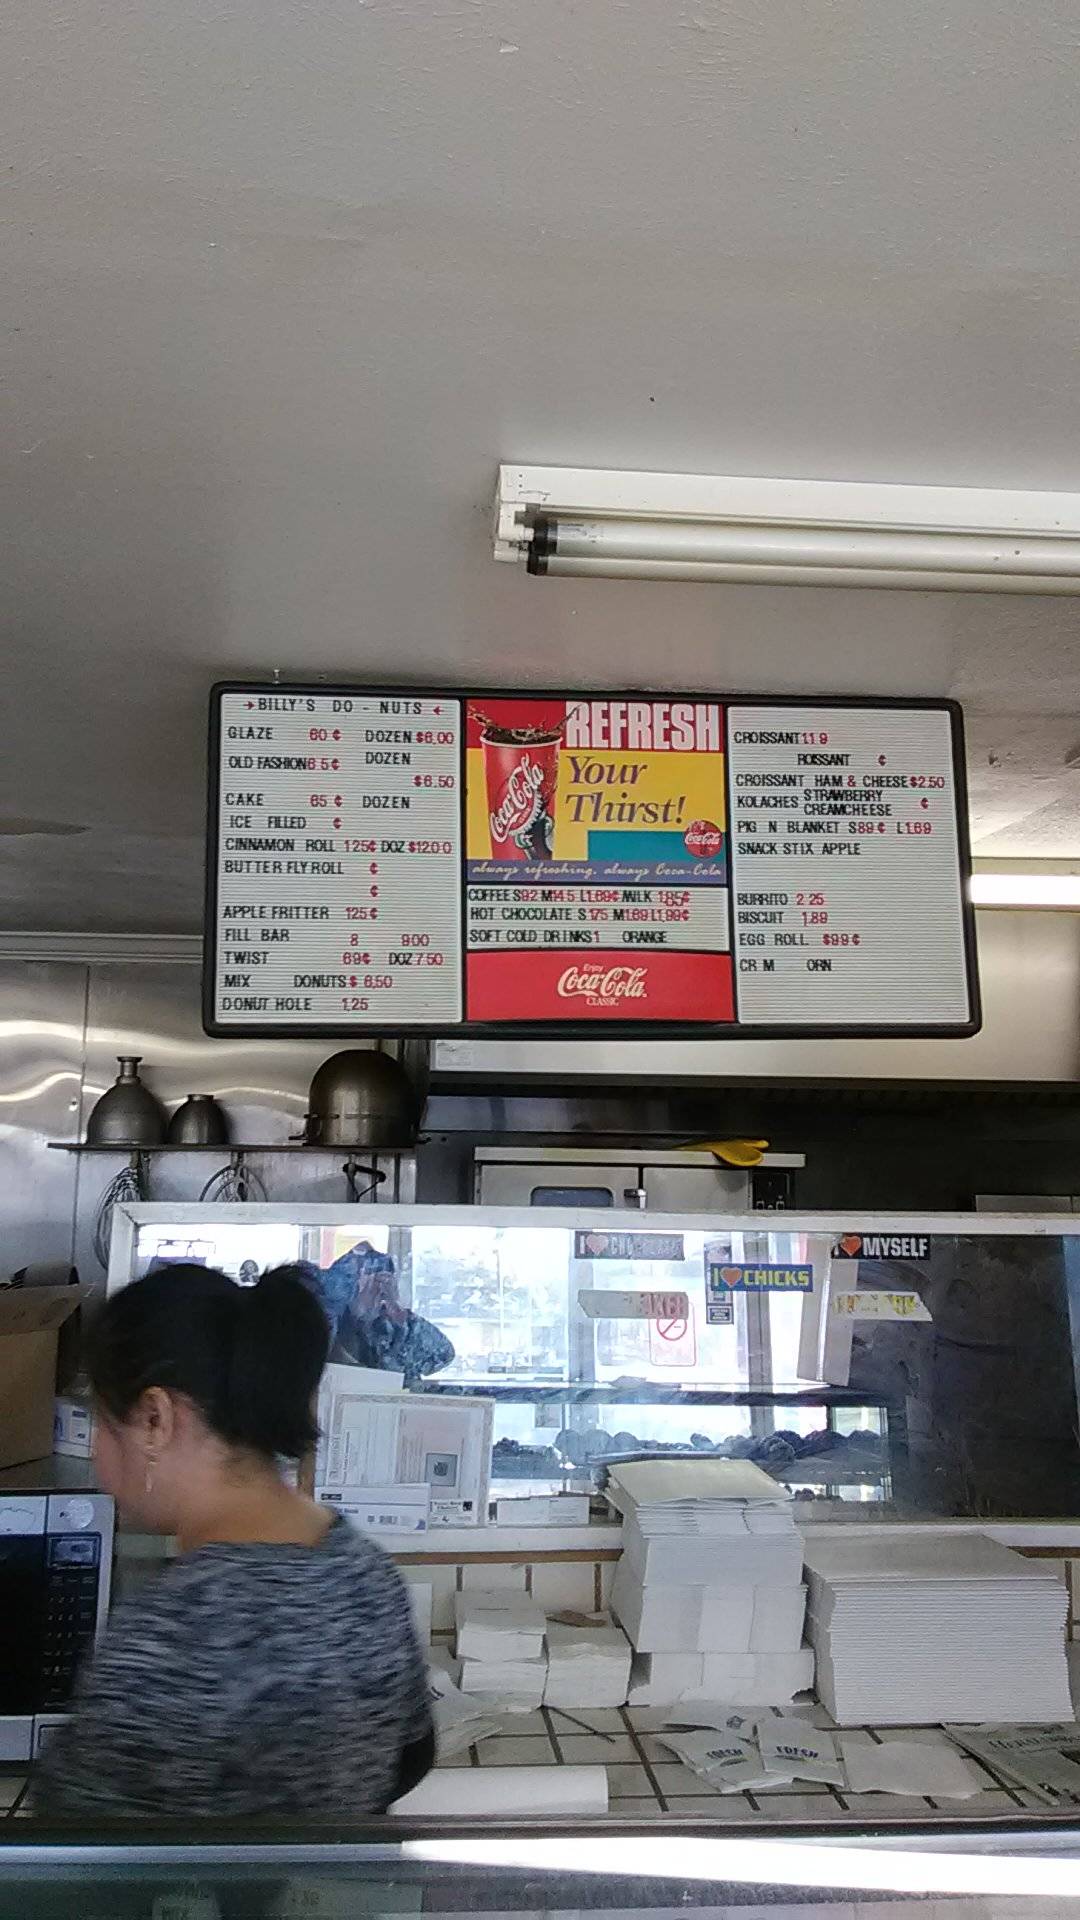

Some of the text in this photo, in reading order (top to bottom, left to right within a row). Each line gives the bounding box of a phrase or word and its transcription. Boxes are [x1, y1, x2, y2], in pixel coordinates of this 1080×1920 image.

[258, 698, 315, 711] BILLY'S
[379, 701, 422, 714] NUTS
[566, 701, 720, 750] REFRESH
[227, 727, 273, 740] GLAZE
[365, 730, 412, 743] DOZEN
[734, 731, 800, 744] CROISSANT
[229, 756, 253, 769] OLD
[257, 757, 307, 770] FASHION
[365, 752, 411, 765] DOZEN
[797, 754, 851, 766] ROISSANT
[566, 755, 648, 784] Your
[735, 774, 804, 787] CROISSANT
[814, 775, 843, 787] HAM
[847, 775, 857, 788] &
[862, 776, 909, 788] CHEESE
[225, 793, 264, 806] CAKE
[362, 796, 410, 809] DOZEN
[803, 789, 883, 801] STRAWBERRY
[566, 791, 686, 824] Thirst!
[737, 796, 799, 809] KOLACHES
[230, 815, 252, 828] ICE
[267, 816, 306, 829] FILLED
[737, 821, 757, 833] PIG
[768, 821, 778, 833] N
[788, 822, 840, 834] BLANKET
[225, 838, 294, 851] CINNAMON
[306, 839, 335, 852] ROLL
[381, 841, 405, 853] DOZ
[738, 843, 861, 855] SNACK STIX APPLE
[468, 889, 512, 901] COFFEE
[621, 890, 651, 903] MILK
[737, 893, 788, 906] BURRITO
[223, 905, 267, 919] APPLE
[272, 906, 329, 919] FRITTER
[471, 907, 494, 920] HOT
[501, 908, 573, 920] CHOCOLATE
[737, 911, 784, 924] BISCUIT
[225, 928, 250, 941] FILL
[260, 928, 290, 941] BAR
[469, 930, 500, 942] SOFT
[506, 930, 537, 942] COLD
[544, 930, 592, 943] DRINKS
[622, 931, 667, 944] ORANGE
[739, 933, 766, 946] EGG
[774, 933, 809, 946] ROLL
[224, 951, 269, 964] TWIST
[388, 952, 412, 965] DOZ
[225, 974, 251, 987] MIX
[293, 974, 346, 987] DONUTS
[222, 997, 269, 1010] DONUT
[275, 997, 312, 1010] HOLE
[863, 1237, 929, 1258] MYSELF
[713, 1267, 810, 1287] I CHICKS
